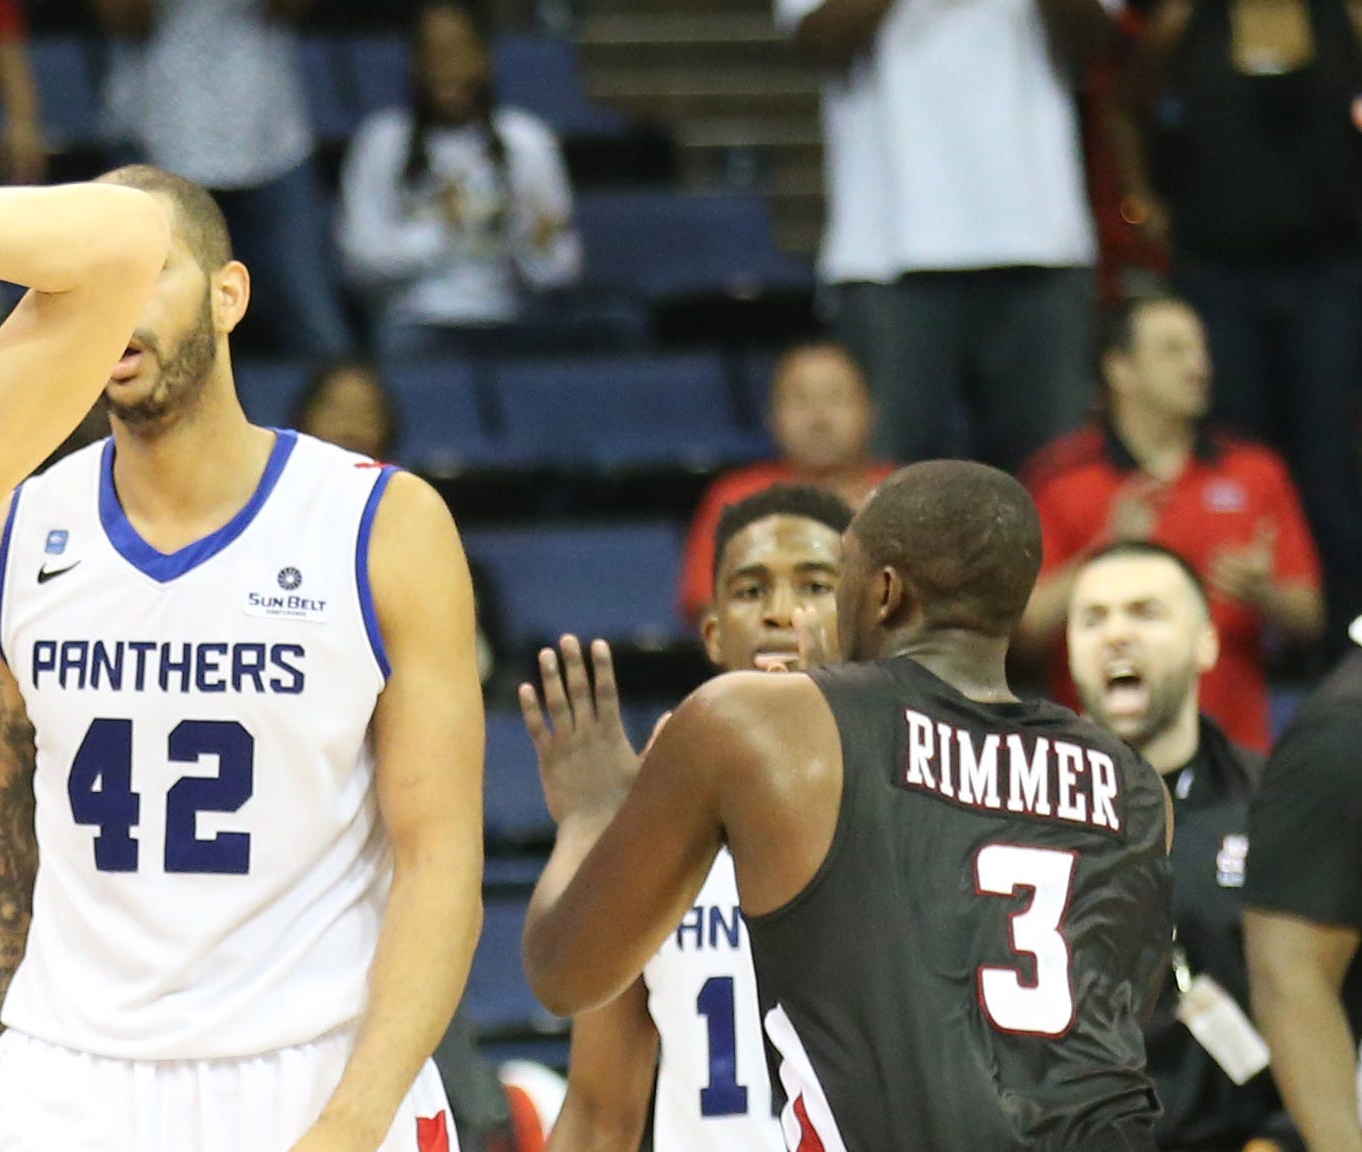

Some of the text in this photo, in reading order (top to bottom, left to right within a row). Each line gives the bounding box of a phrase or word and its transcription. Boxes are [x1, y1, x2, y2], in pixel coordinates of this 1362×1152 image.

[32, 640, 306, 695] PANTHERS
[249, 592, 326, 611] SUN BELT
[67, 717, 256, 876] 42
[904, 708, 1121, 833] RIMMER
[975, 844, 1079, 1038] 3
[696, 974, 749, 1118] 1
